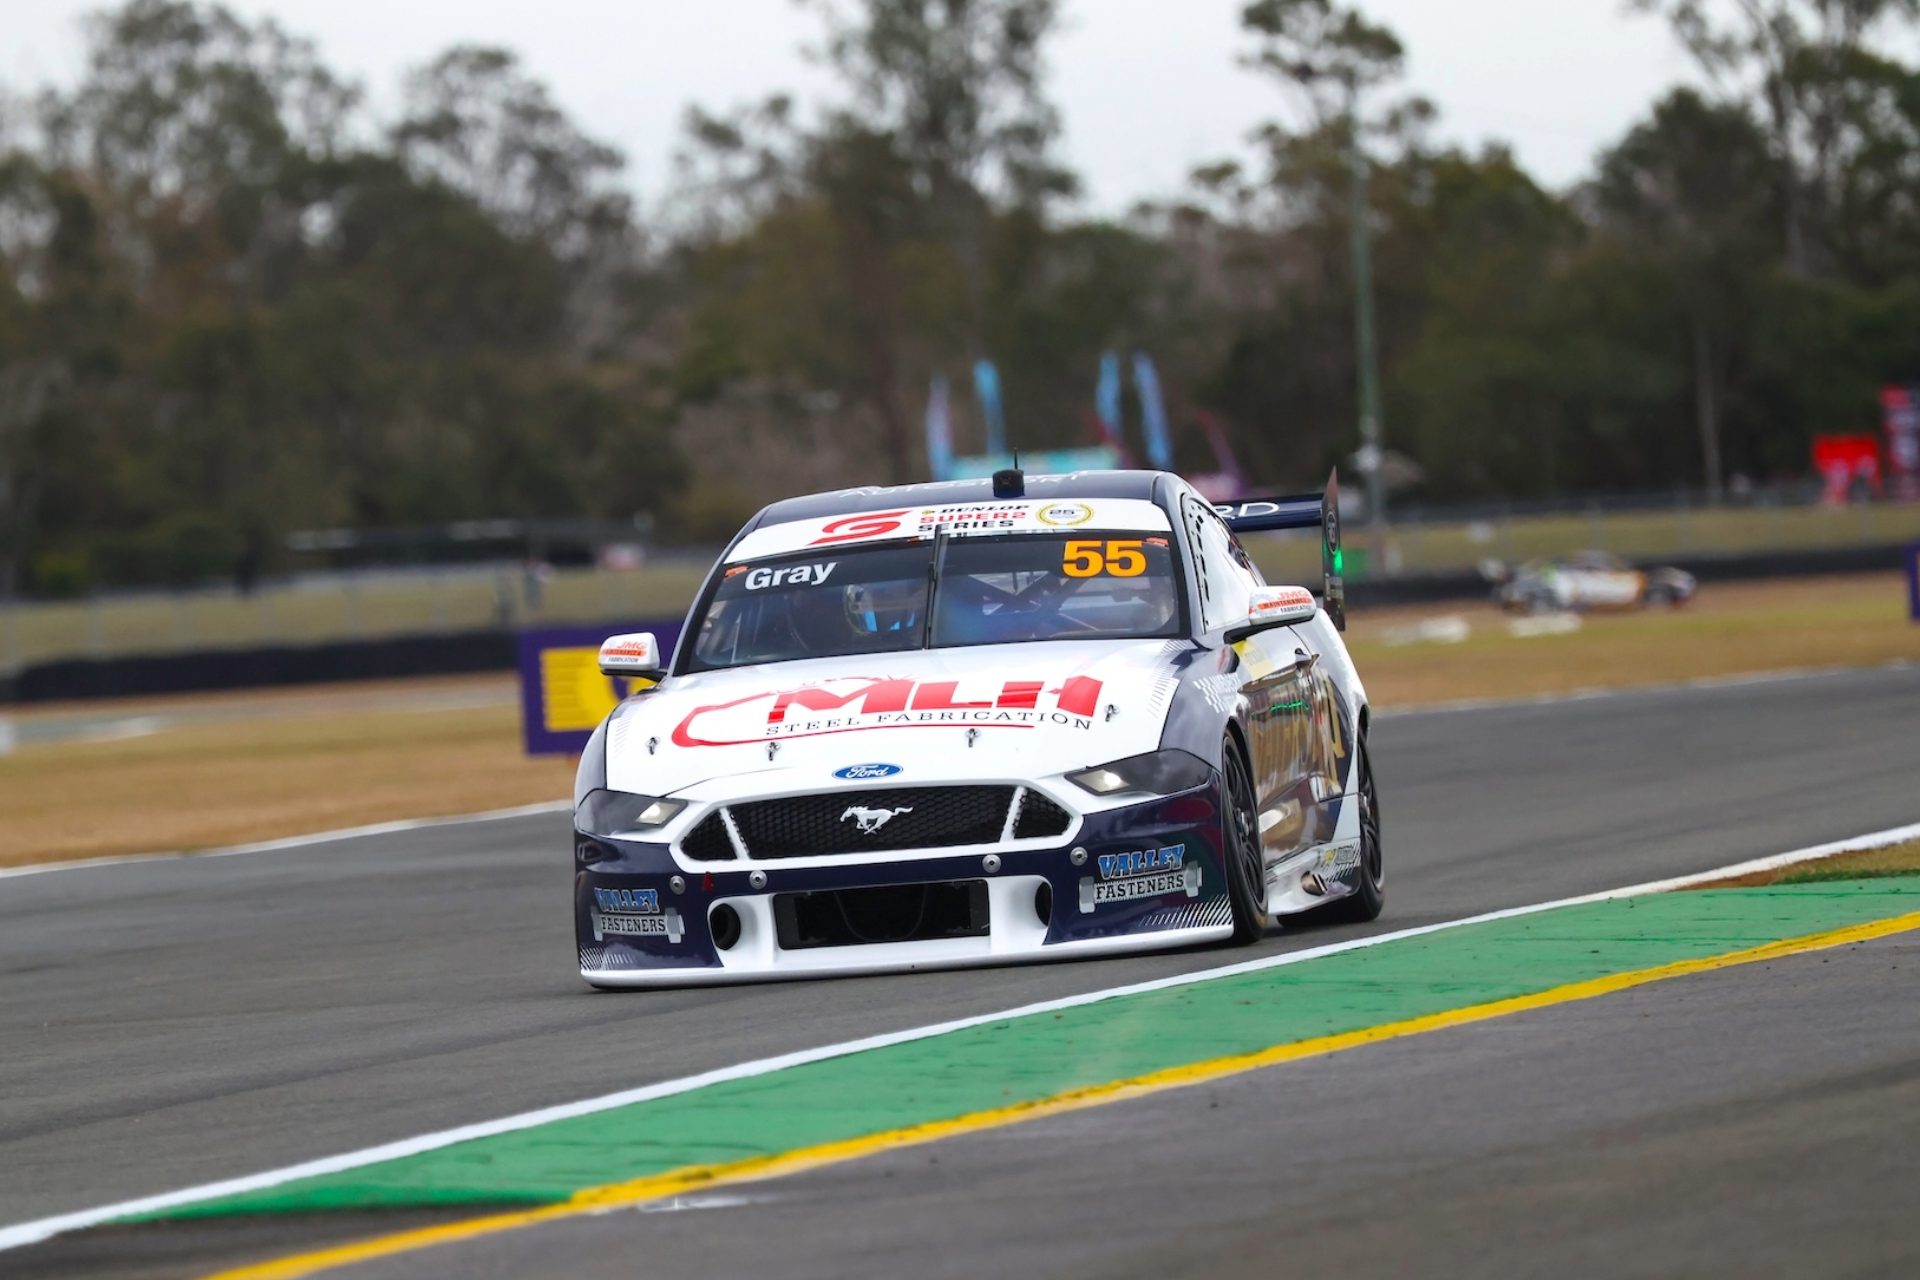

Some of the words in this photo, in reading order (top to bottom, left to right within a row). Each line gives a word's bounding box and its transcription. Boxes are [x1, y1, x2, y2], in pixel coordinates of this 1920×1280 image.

[838, 470, 1089, 498] AUTOSRT
[920, 511, 1026, 524] SUPER2
[940, 505, 1030, 514] DUNLOP
[918, 519, 1014, 532] SERIES
[1062, 539, 1148, 577] 55
[744, 561, 838, 590] Gray
[1277, 590, 1309, 600] JMG
[617, 641, 647, 650] JMG
[766, 716, 860, 736] STEEL
[876, 711, 1093, 731] FABRICATION
[845, 764, 889, 779] Ford
[1098, 844, 1186, 881] VALLEY
[1096, 874, 1184, 900] FASTENERS
[594, 887, 660, 914] VALLEY
[601, 918, 666, 933] FASTENERS
